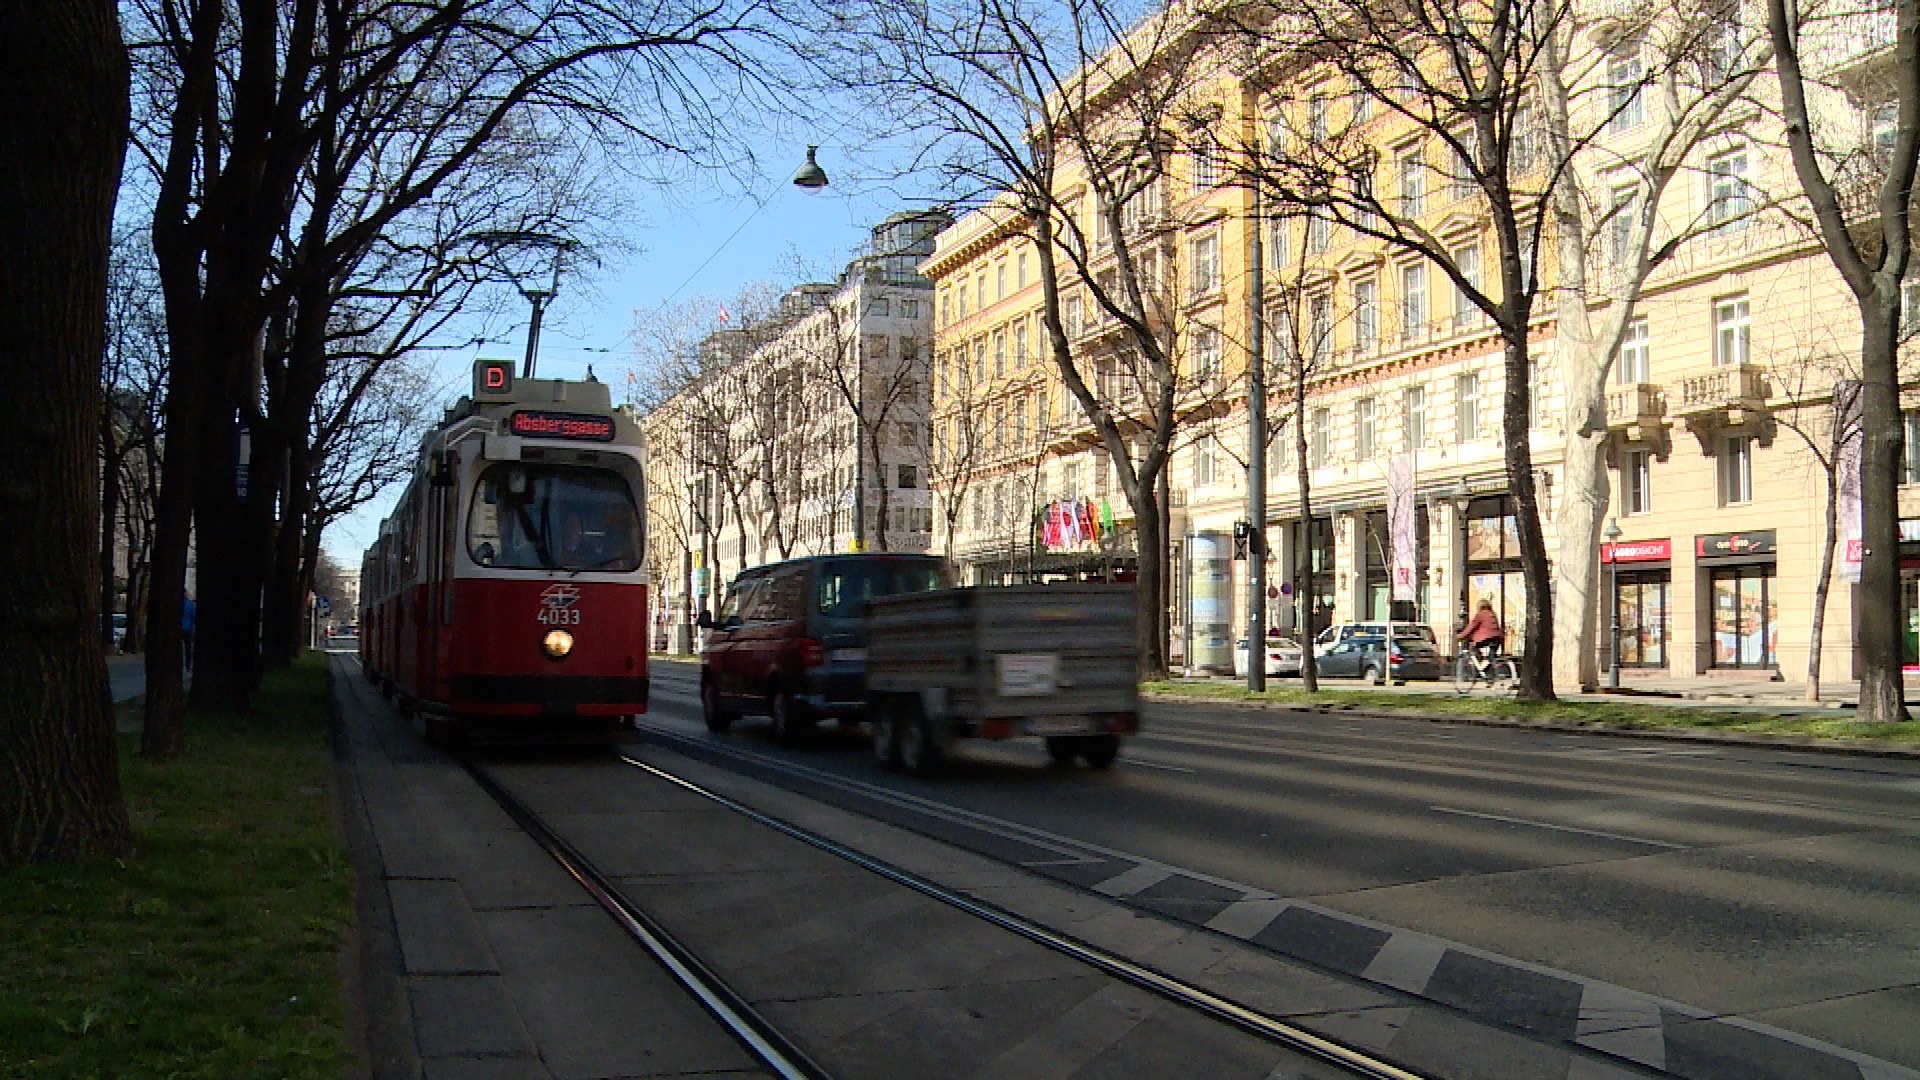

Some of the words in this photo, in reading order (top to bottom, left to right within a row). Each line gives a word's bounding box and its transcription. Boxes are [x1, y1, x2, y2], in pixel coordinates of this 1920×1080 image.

[488, 368, 504, 387] D
[515, 413, 609, 436] Absberggasse
[537, 608, 581, 625] 4033
